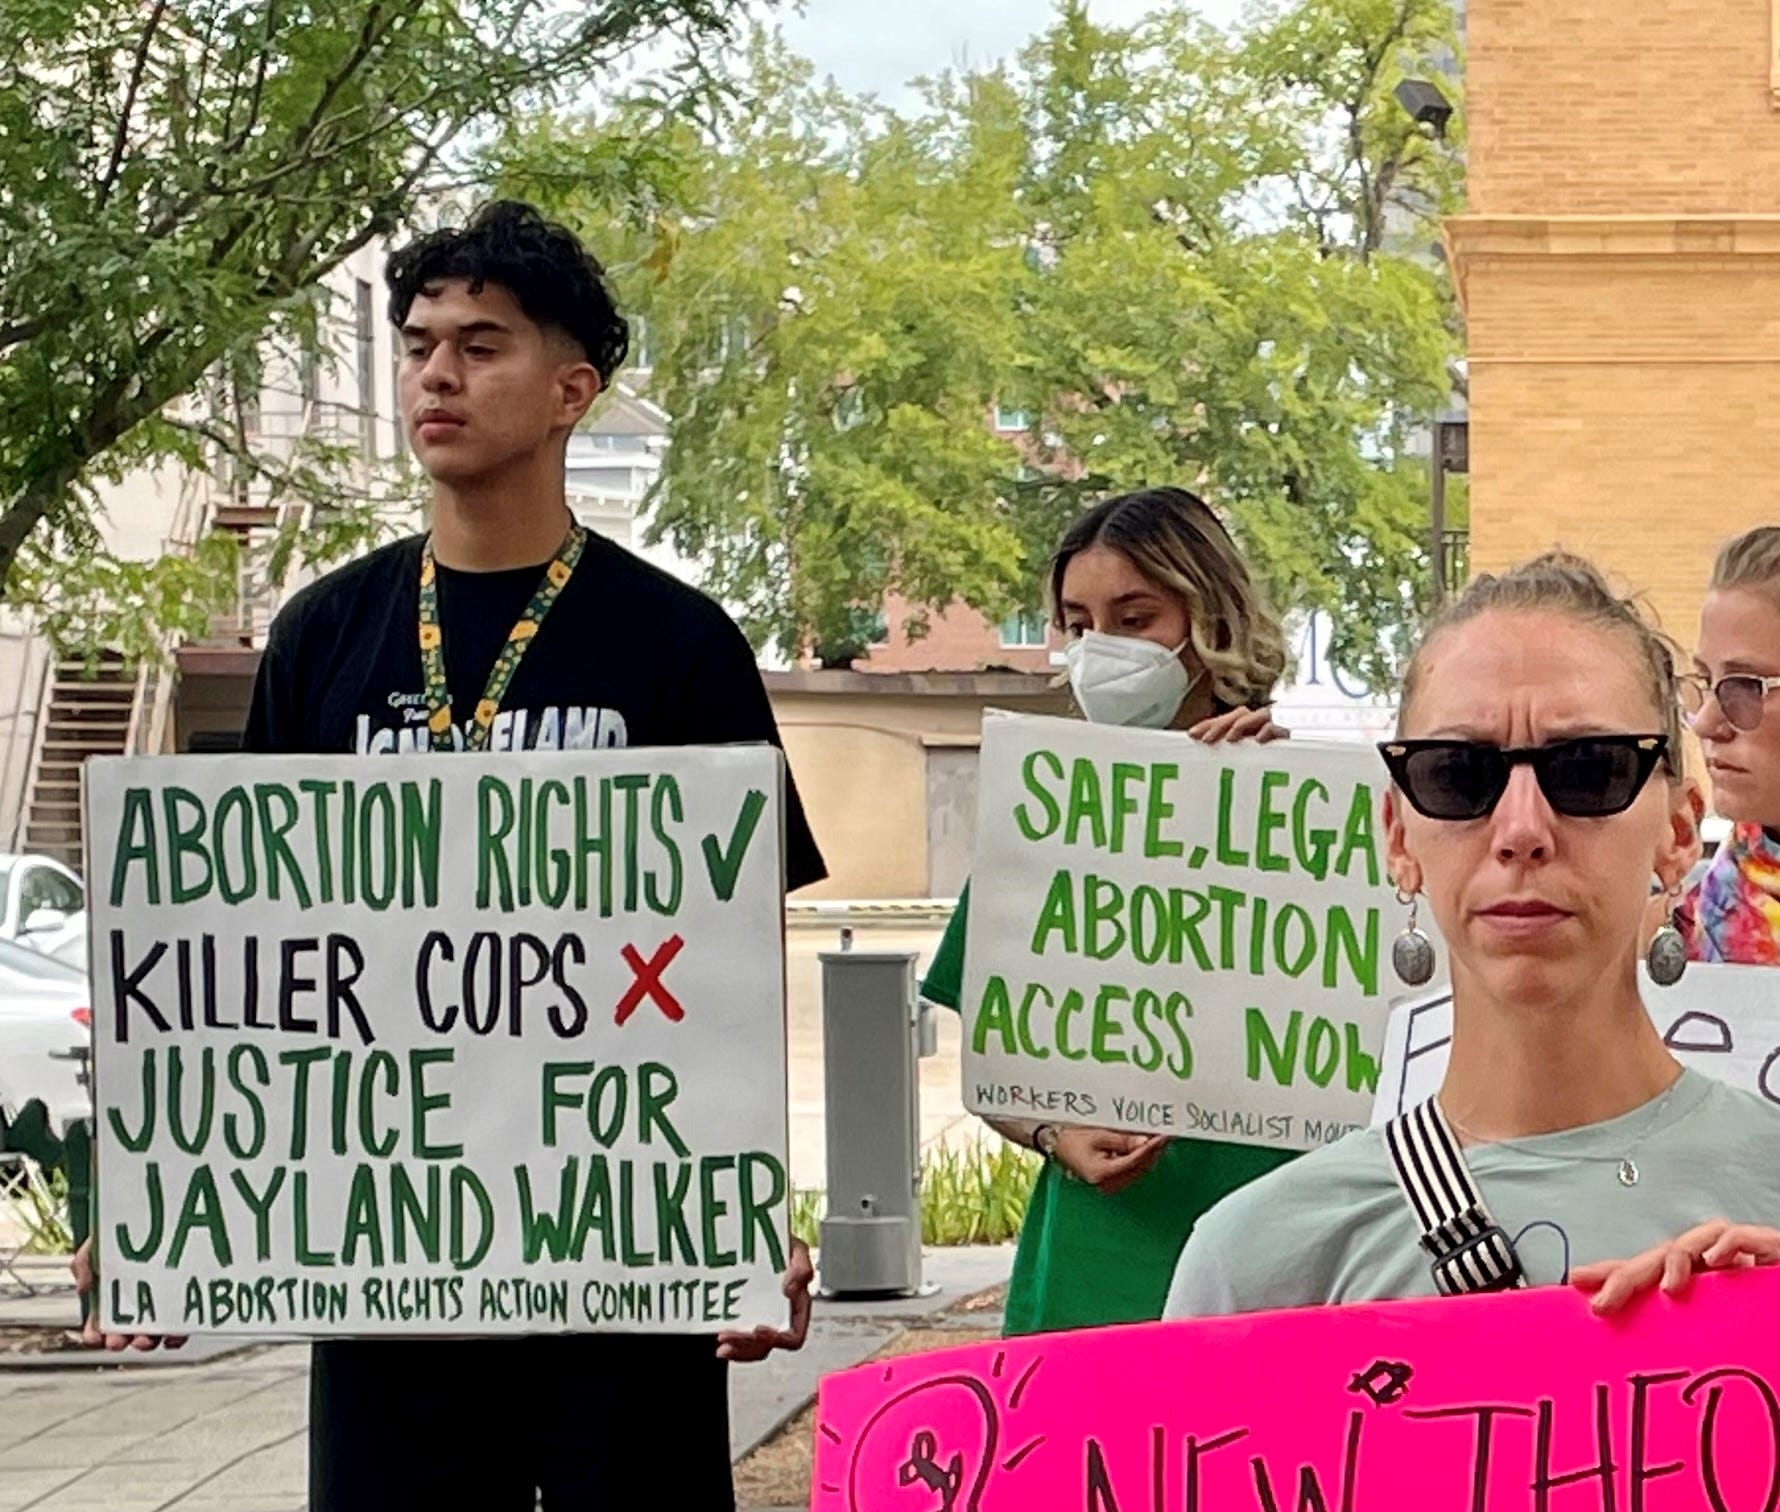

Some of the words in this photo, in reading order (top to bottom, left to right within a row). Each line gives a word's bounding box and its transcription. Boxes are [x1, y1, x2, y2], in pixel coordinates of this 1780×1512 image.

[110, 777, 443, 911] ABORTION
[476, 774, 685, 917] RIGHTS
[1216, 767, 1398, 888] LEGA
[110, 929, 377, 1046] KILLER
[416, 931, 588, 1038] COPS
[1031, 869, 1380, 997] ABORTION
[971, 975, 1195, 1080] ACCESS
[107, 1043, 464, 1160] JUSTICE
[541, 1060, 692, 1158] FOR
[975, 1083, 1098, 1116] WORKERS
[1112, 1095, 1175, 1127] VOICE
[1186, 1102, 1294, 1141] SOCIALIST
[115, 1161, 495, 1270] JAYLAND
[515, 1150, 788, 1273] WALKER
[110, 1279, 156, 1326] LA
[184, 1278, 347, 1327] ABORTION
[363, 1277, 465, 1324] RIGHTS
[479, 1279, 569, 1323] ACTION
[582, 1277, 749, 1323] COMMITTEE
